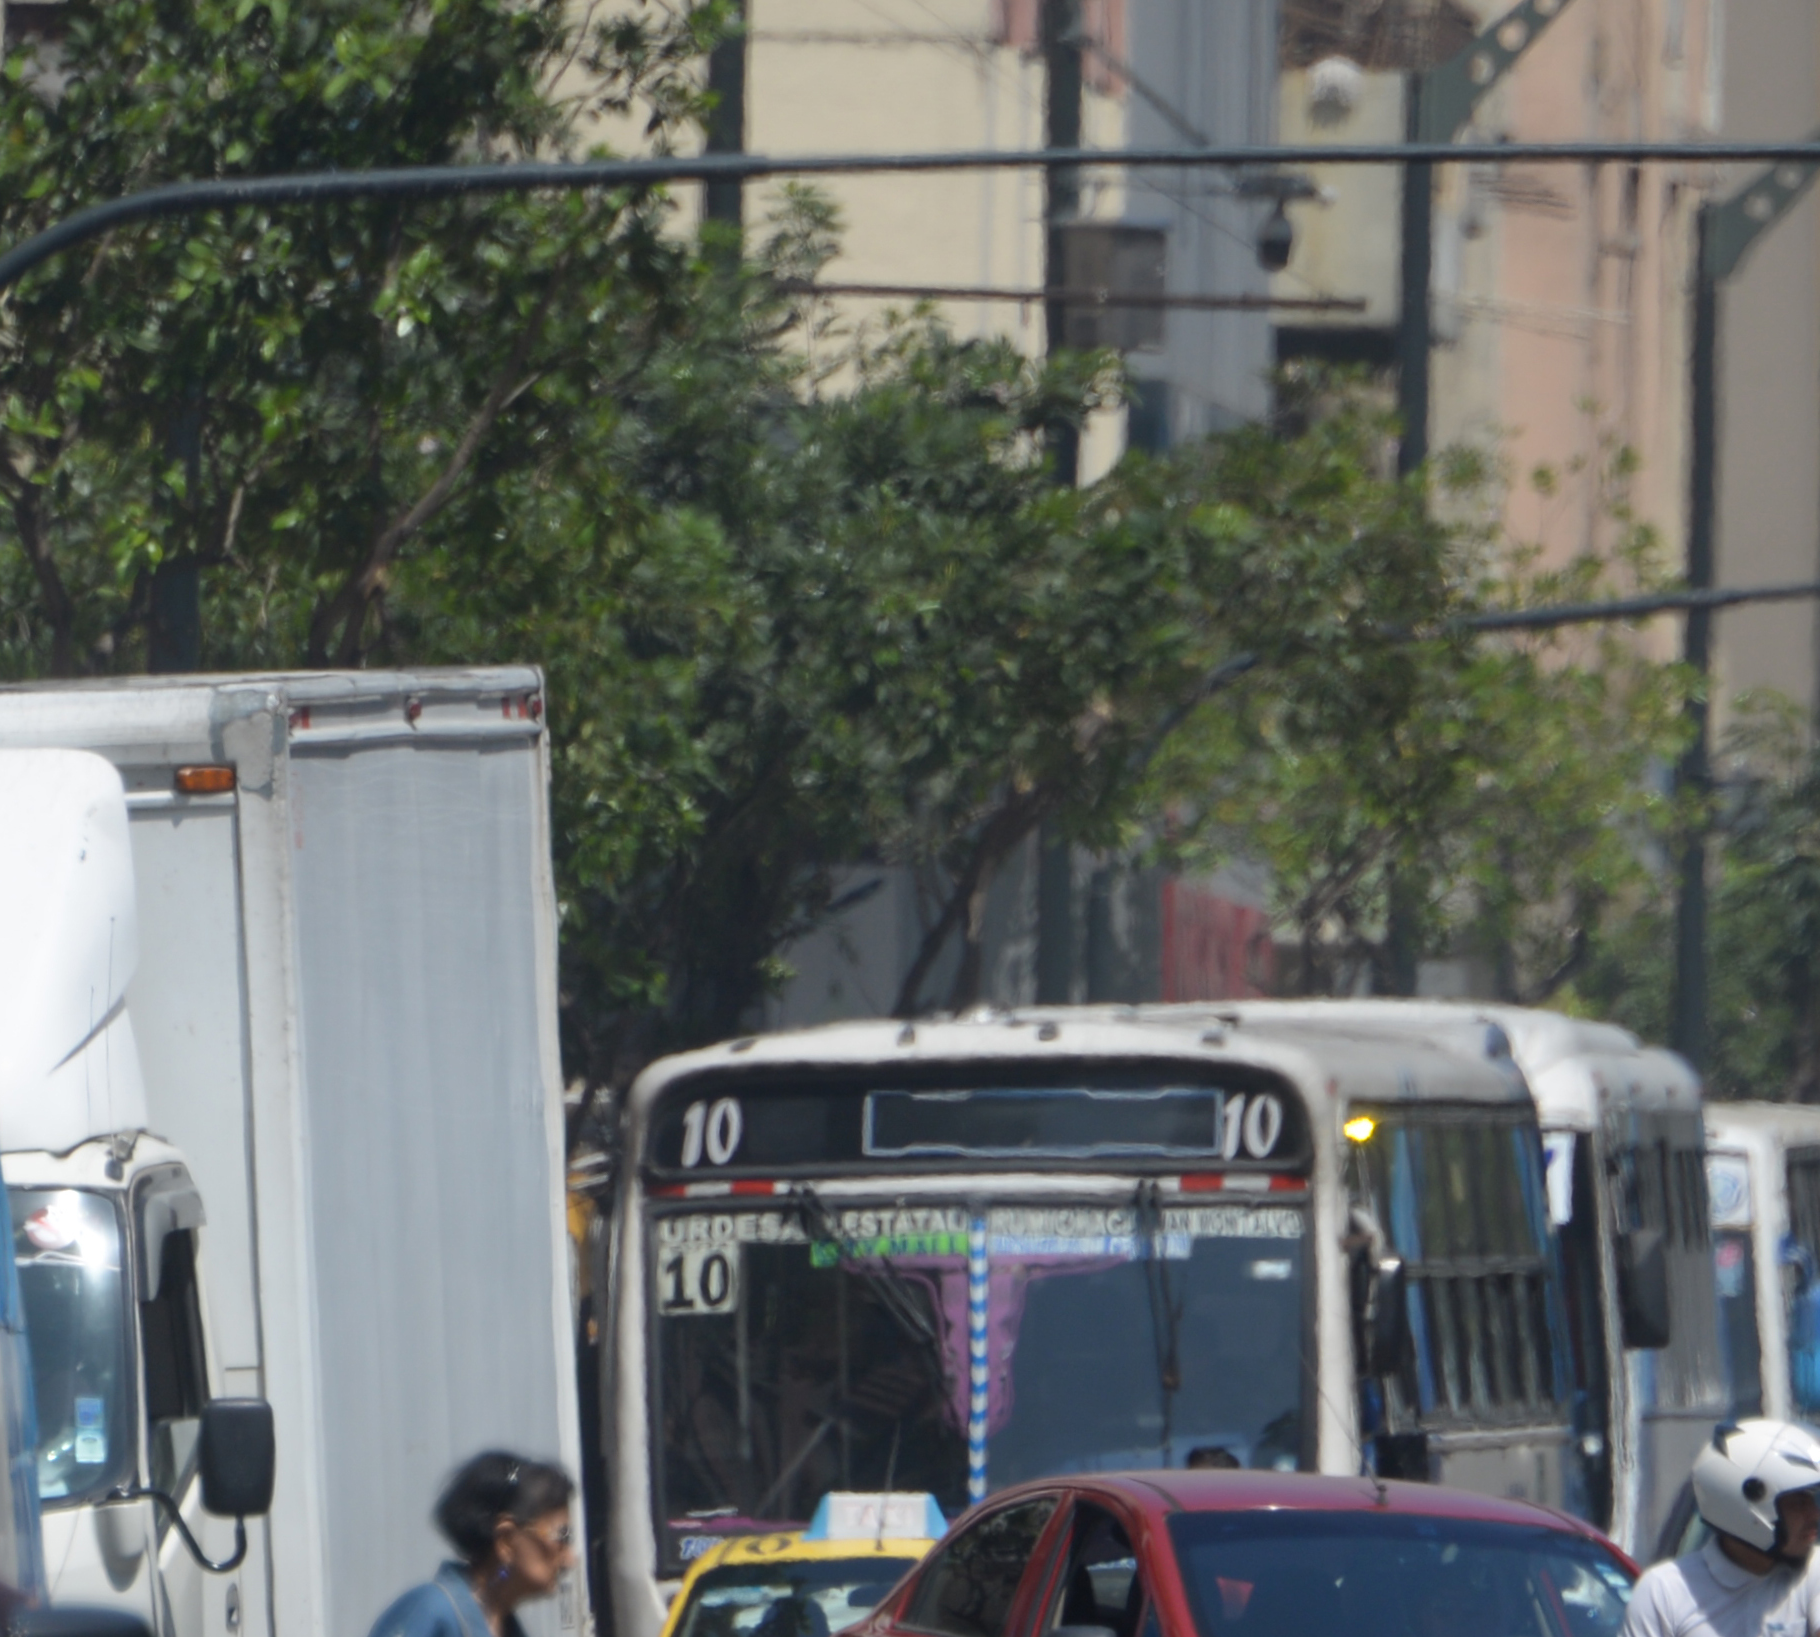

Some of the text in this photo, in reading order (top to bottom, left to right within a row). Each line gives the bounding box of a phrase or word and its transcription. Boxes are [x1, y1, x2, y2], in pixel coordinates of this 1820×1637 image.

[680, 1096, 744, 1169] 10
[1221, 1092, 1284, 1160] 10
[660, 1211, 809, 1242] URDESA
[663, 1252, 731, 1311] 10
